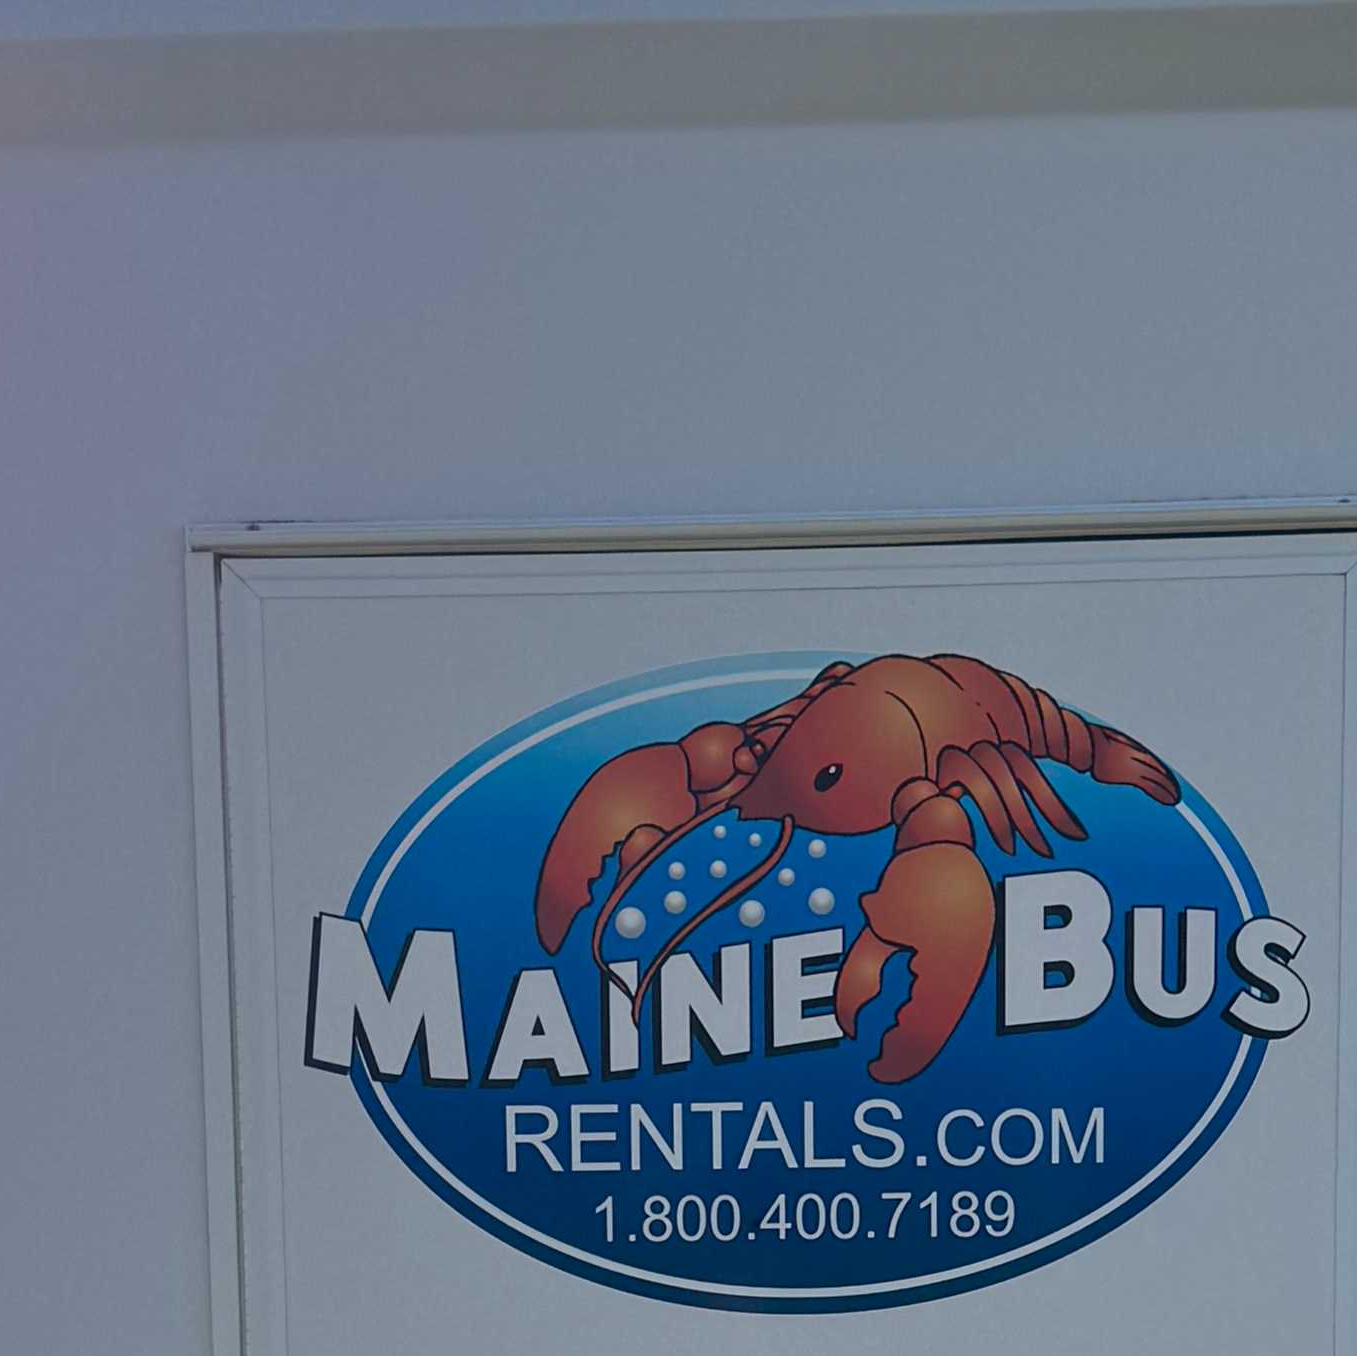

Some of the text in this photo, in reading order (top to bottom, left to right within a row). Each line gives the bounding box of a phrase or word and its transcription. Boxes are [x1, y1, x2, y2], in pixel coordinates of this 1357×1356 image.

[304, 868, 1311, 1087] MAINE BUS
[504, 1097, 1105, 1172] RENTALS.COM
[595, 1190, 1016, 1244] 1.800.400.7189
